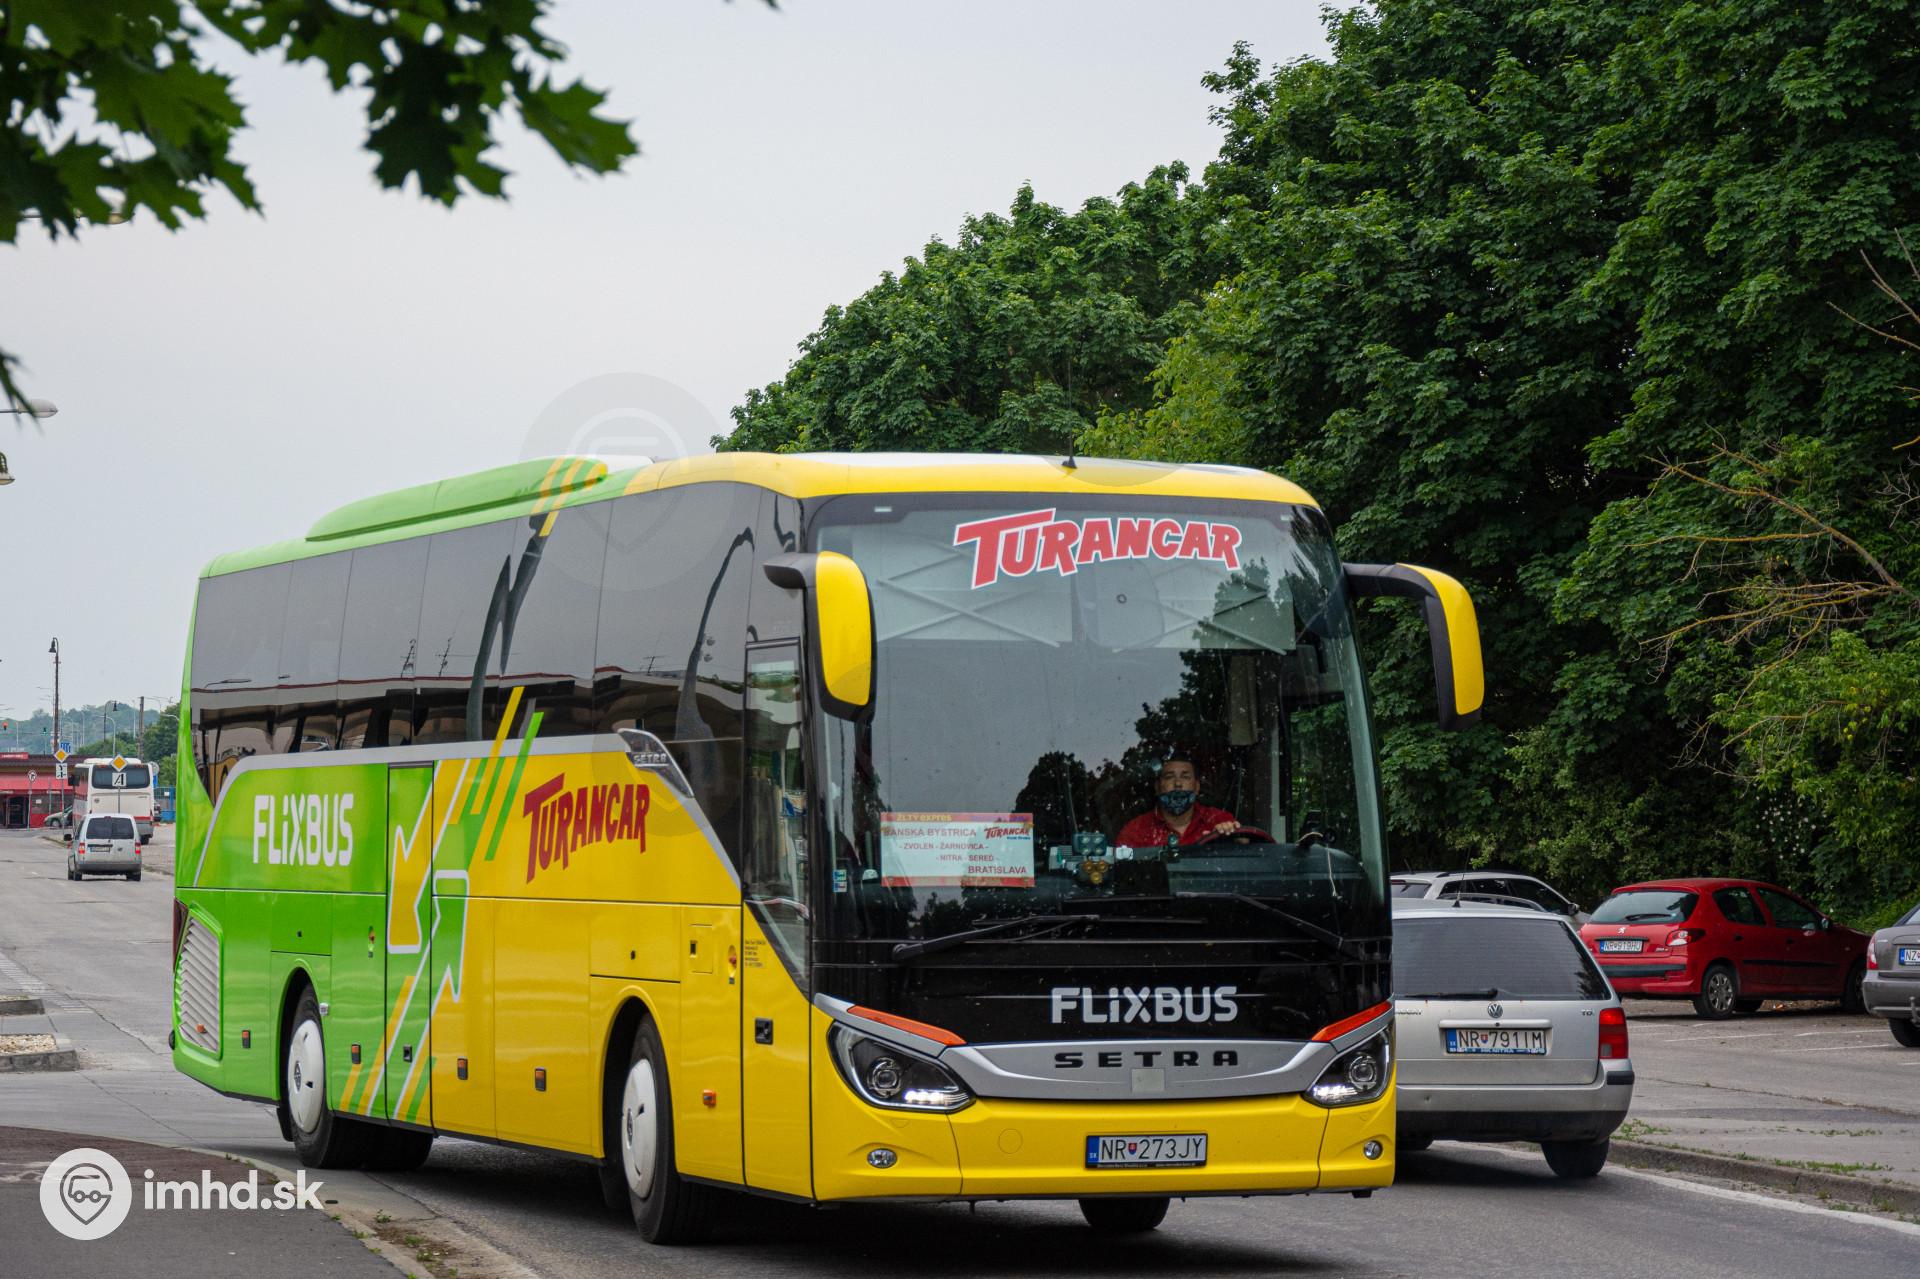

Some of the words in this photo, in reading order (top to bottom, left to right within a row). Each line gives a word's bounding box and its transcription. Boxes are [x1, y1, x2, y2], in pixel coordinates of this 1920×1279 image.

[953, 508, 1242, 590] TURANCAR
[523, 772, 650, 884] TURANCAR
[927, 828, 977, 837] BYSTRICA
[904, 842, 934, 850] ZVOLEN
[967, 865, 1027, 874] BRATISLAVA
[1458, 1030, 1480, 1048] NR
[1054, 1050, 1239, 1068] SETRA
[1101, 1139, 1127, 1160] NR
